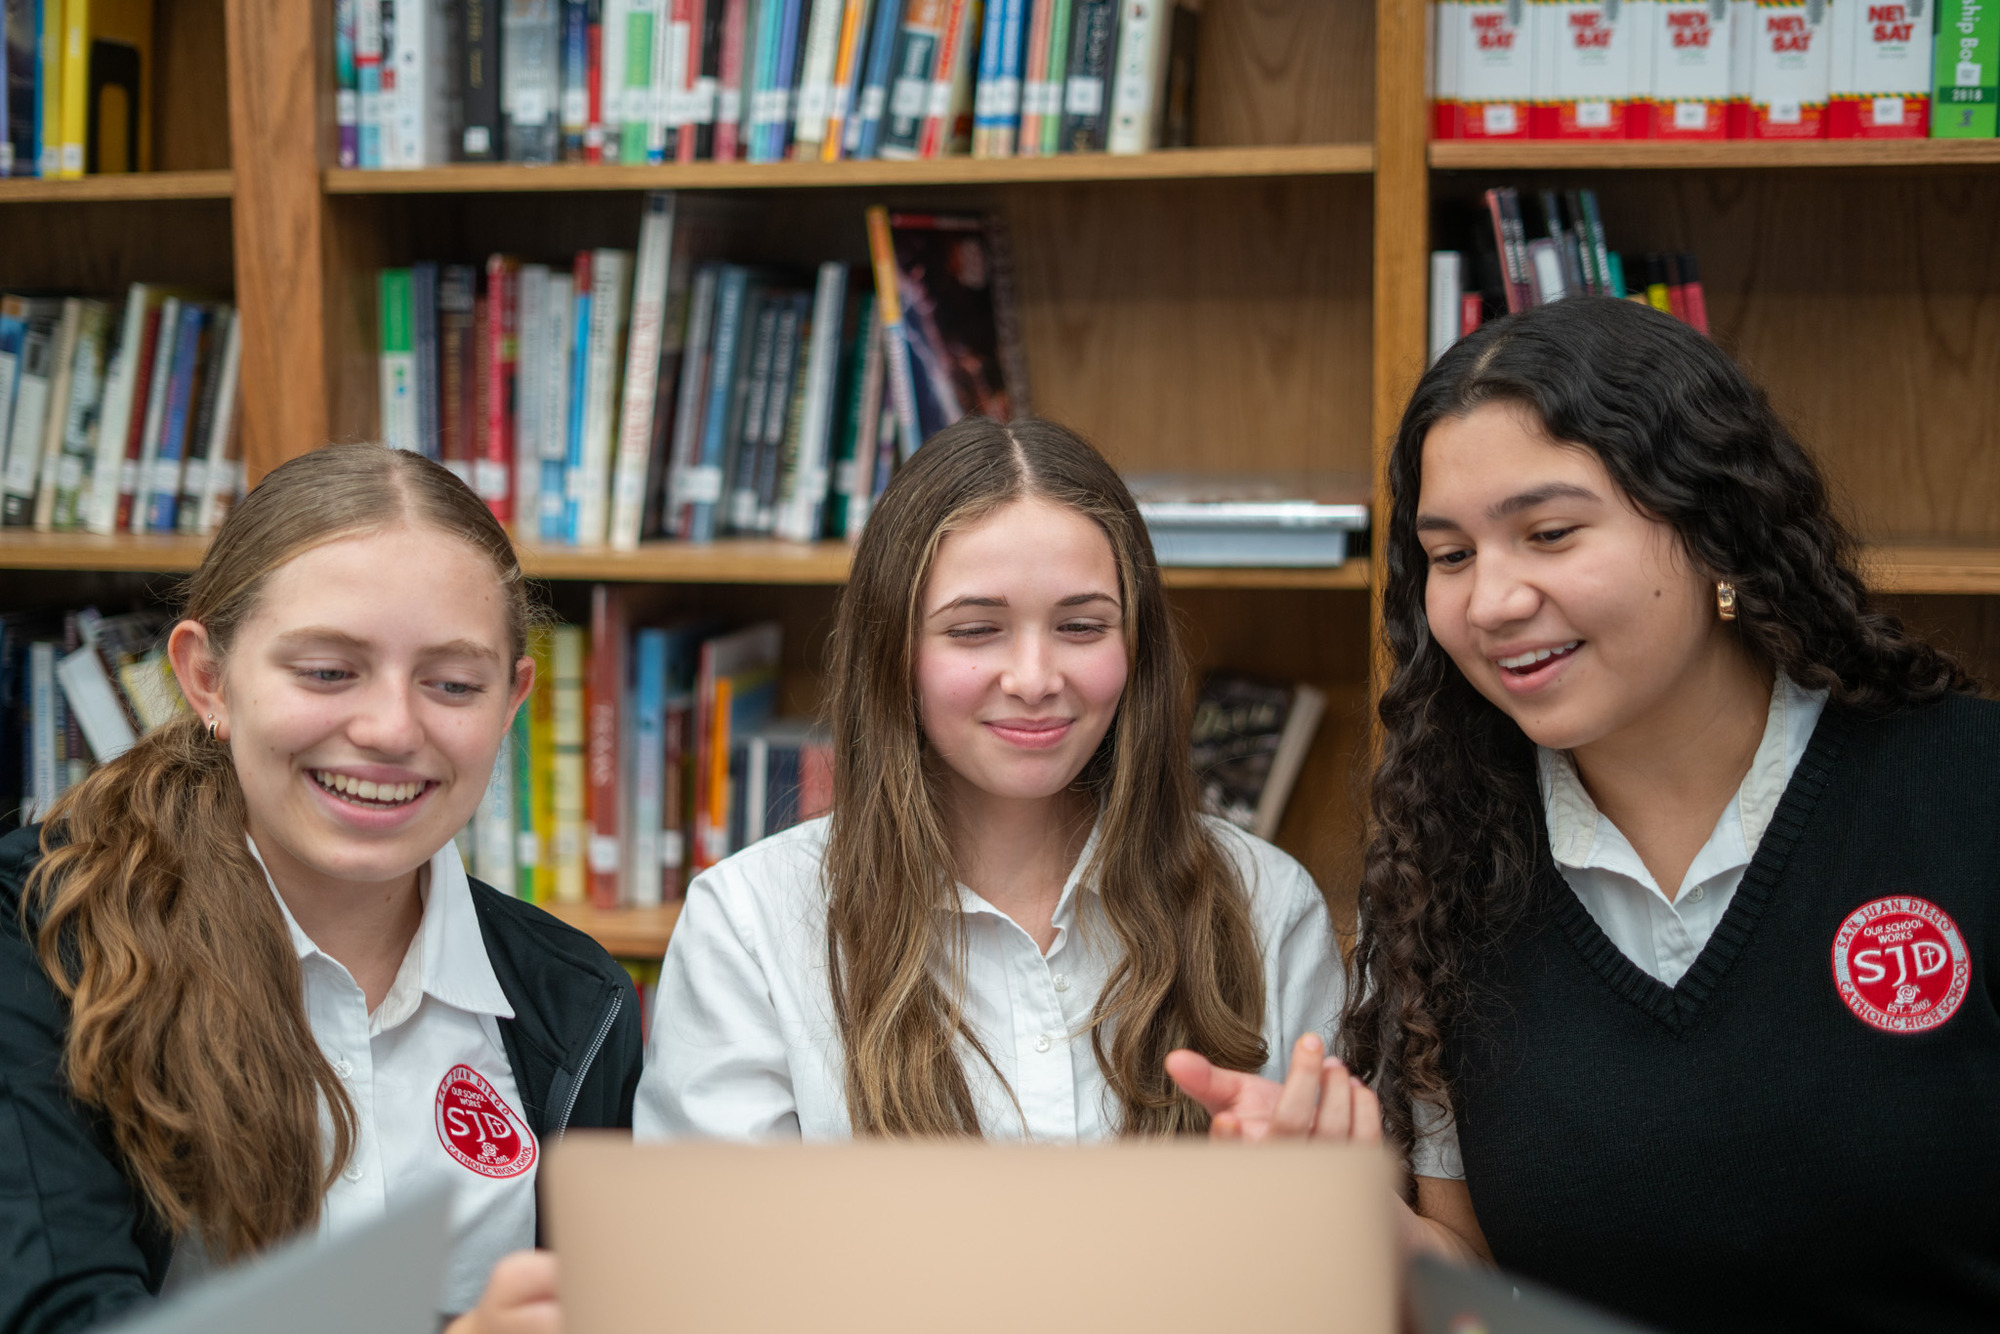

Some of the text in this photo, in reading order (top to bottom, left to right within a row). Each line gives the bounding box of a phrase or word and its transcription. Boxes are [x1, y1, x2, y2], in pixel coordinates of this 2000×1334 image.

[1477, 29, 1514, 49] SAT
[1573, 28, 1612, 48] SAT
[1672, 29, 1711, 48] SAT
[1772, 32, 1812, 52] SAT
[1873, 23, 1914, 42] SAT
[1952, 89, 1983, 101] 2018
[1838, 899, 1952, 949] SAN JUAN DIEGO
[1864, 919, 1923, 936] OUR SCHOOL
[1878, 931, 1913, 944] WORKS
[1853, 941, 1948, 987] SJD
[1840, 959, 1967, 1029] CATHOLIC HIGH SCHOOL
[1910, 999, 1931, 1013] 2002
[437, 1070, 510, 1116] SAN JUAN DIEGO
[451, 1087, 487, 1102] OUR SCHOOL
[459, 1097, 482, 1108] WORKS
[447, 1107, 512, 1142] SJD
[447, 1144, 532, 1175] CATHOLIC HIGH SCHOOL
[495, 1155, 510, 1164] 2002
